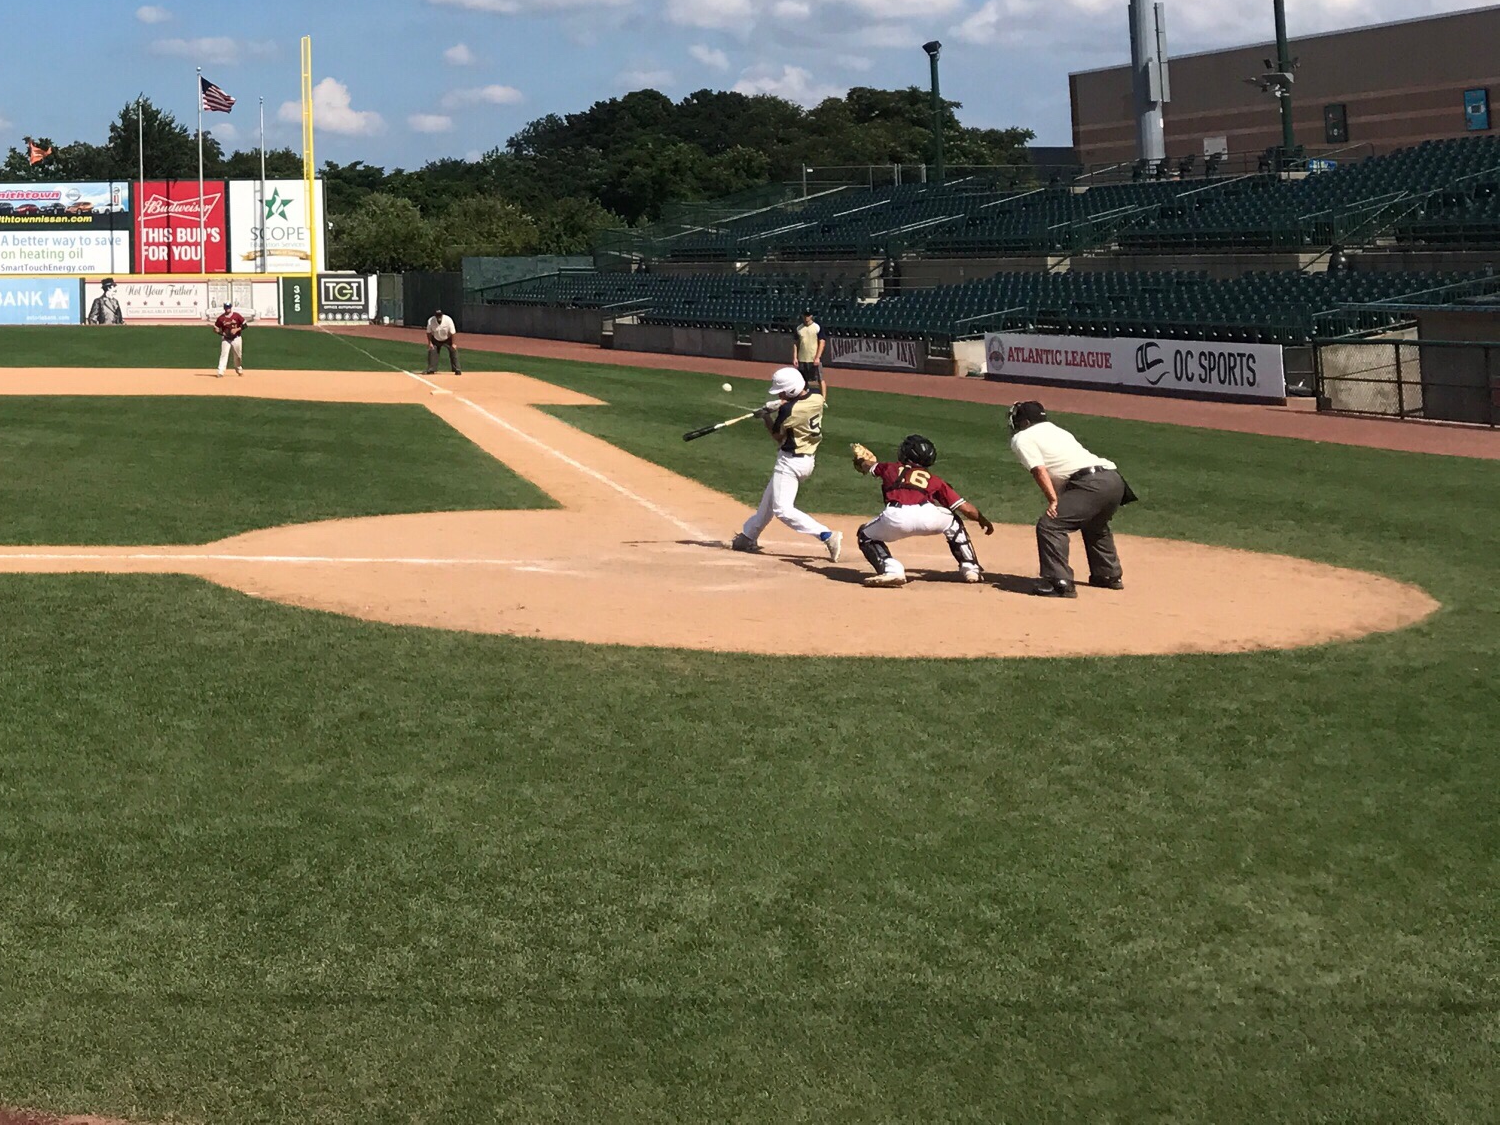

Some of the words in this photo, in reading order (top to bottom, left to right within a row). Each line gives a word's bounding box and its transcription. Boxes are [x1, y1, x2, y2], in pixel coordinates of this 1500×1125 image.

[141, 227, 173, 243] THIS
[250, 226, 304, 241] SCOPE
[0, 235, 9, 246] A
[12, 235, 50, 246] better
[52, 237, 77, 250] way
[79, 236, 91, 246] to
[95, 237, 122, 246] save
[1, 250, 16, 259] on
[20, 248, 65, 262] heating
[69, 248, 83, 259] oil
[142, 245, 169, 261] FOR
[0, 263, 95, 273] SmartTouchEnergy.com
[125, 284, 142, 295] Not
[143, 284, 164, 298] Your
[166, 284, 198, 298] Father's
[293, 285, 301, 312] 325
[325, 283, 359, 300] TGI
[831, 338, 864, 360] SHORT
[865, 339, 894, 356] STOP
[896, 341, 917, 368] INN
[1007, 346, 1063, 366] ATLANTIC
[1064, 350, 1113, 369] LEAGUE
[1173, 349, 1195, 382] OC
[1198, 350, 1257, 388] SPORTS
